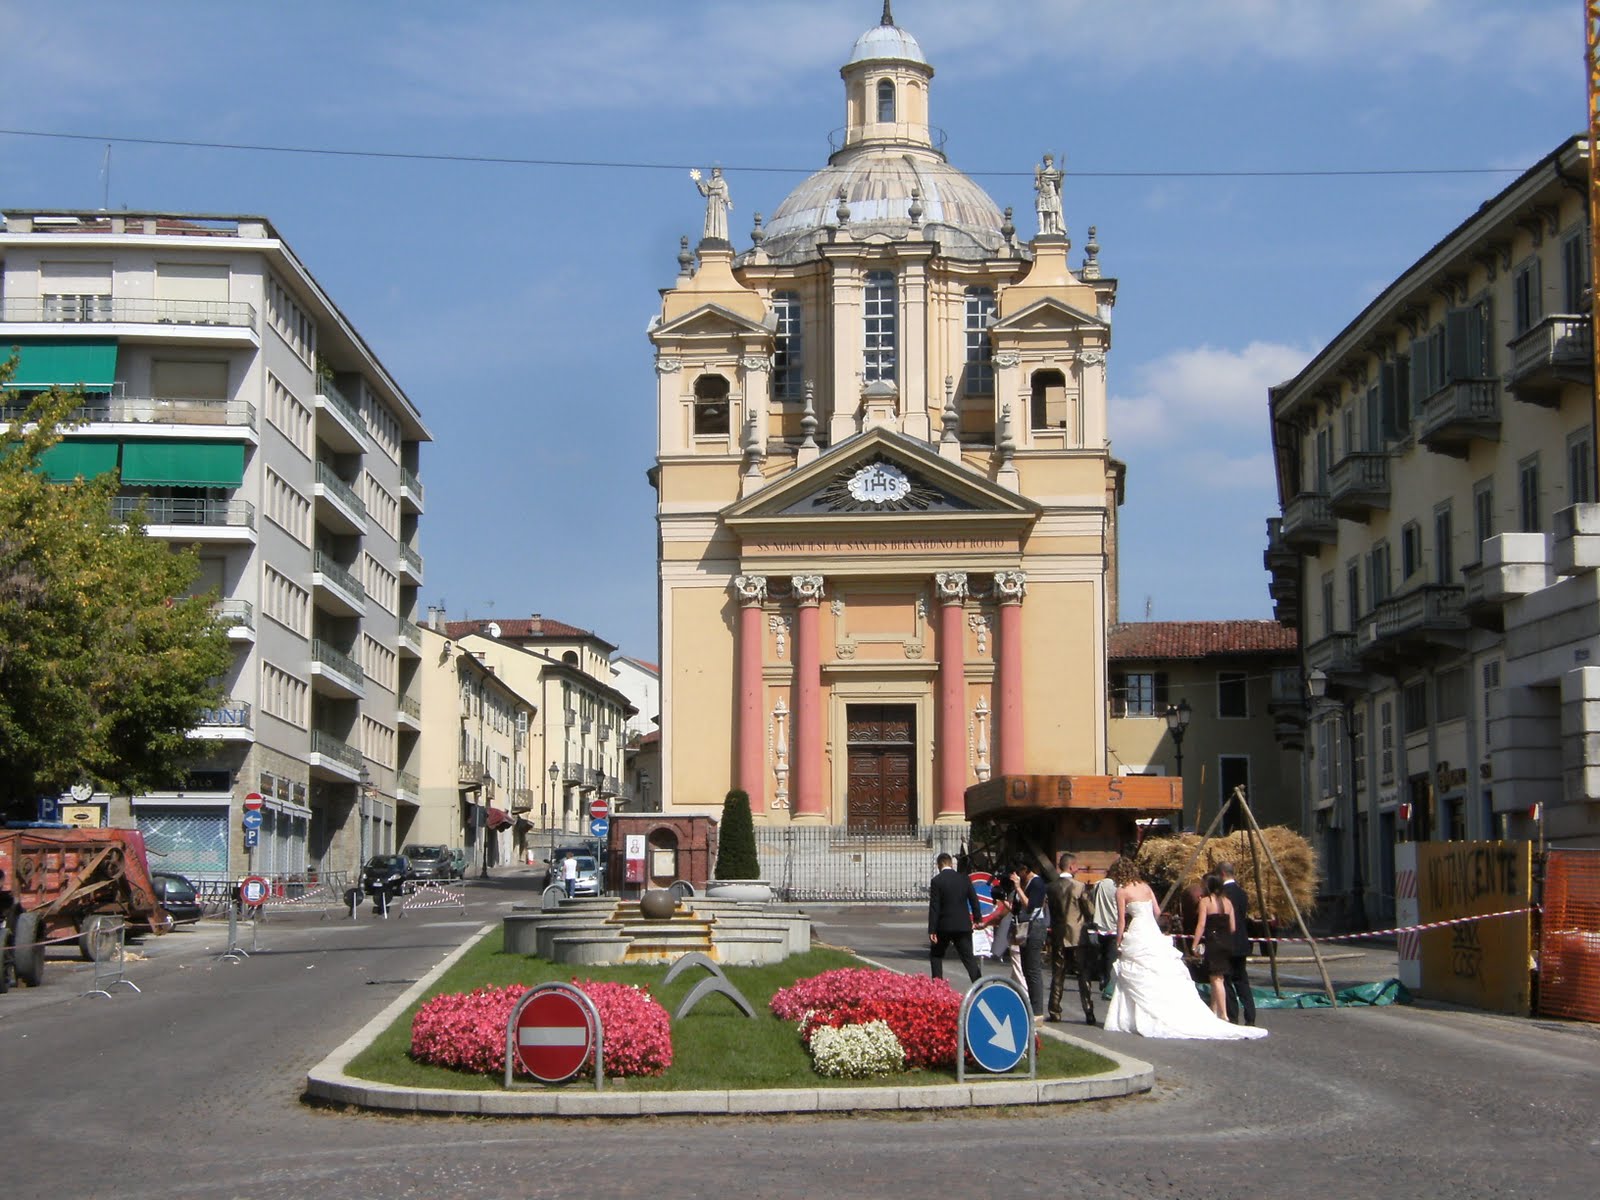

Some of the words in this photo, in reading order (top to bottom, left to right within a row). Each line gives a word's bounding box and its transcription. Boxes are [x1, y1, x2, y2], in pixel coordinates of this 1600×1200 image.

[864, 478, 897, 492] IHS
[890, 539, 953, 551] BERNARDINO
[970, 538, 1004, 549] ROCHO
[1012, 779, 1176, 804] ORSI
[42, 799, 54, 818] P
[249, 831, 256, 839] P
